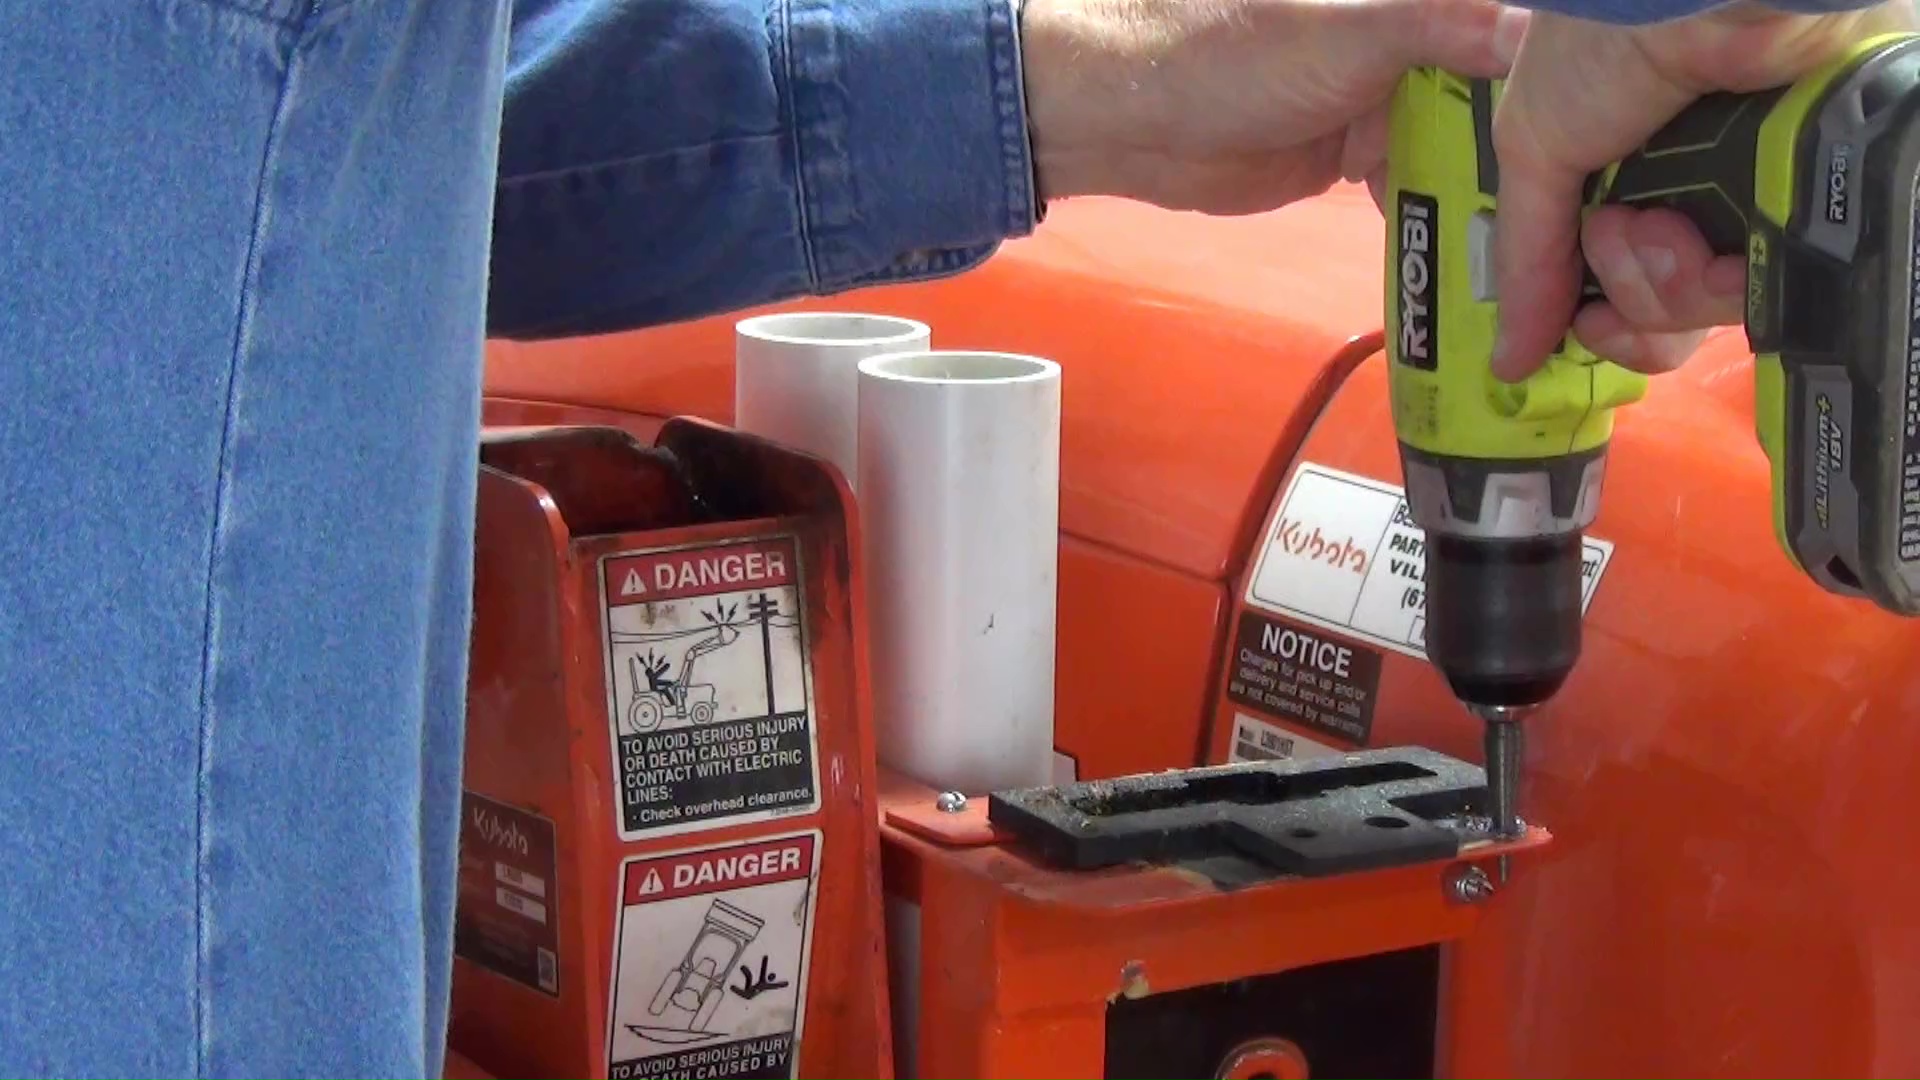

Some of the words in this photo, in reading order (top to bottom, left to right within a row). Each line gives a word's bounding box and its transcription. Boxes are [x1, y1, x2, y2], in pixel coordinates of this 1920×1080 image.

[1830, 145, 1846, 220] RYOBI
[1402, 203, 1429, 359] RYOBI
[1830, 421, 1842, 470] 18V
[1276, 518, 1366, 573] Kubota
[655, 552, 787, 591] DANGER
[1262, 623, 1352, 678] NOTICE
[623, 739, 642, 755] TO
[646, 732, 689, 752] AVOID
[692, 723, 754, 746] SERIOUS
[757, 716, 807, 735] INJURY
[625, 756, 646, 772] OR
[650, 750, 696, 768] DEATH
[701, 741, 757, 761] CAUSED
[760, 737, 780, 750] BY
[626, 765, 692, 788] CONTACT
[696, 759, 731, 778] WITH
[735, 750, 803, 773] ELECTRIC
[627, 787, 673, 805] LINES:
[640, 806, 682, 823] Check
[685, 796, 745, 817] overhead
[748, 788, 812, 807] clearance.
[473, 807, 529, 857] Kubota
[673, 847, 801, 889] DANGER
[612, 1066, 631, 1080] TO
[633, 1057, 676, 1077] AVOID
[679, 1046, 740, 1069] SERIOUS
[742, 1037, 792, 1057] INJURY
[695, 1056, 761, 1080] CAUSED
[766, 1052, 788, 1068] BY
